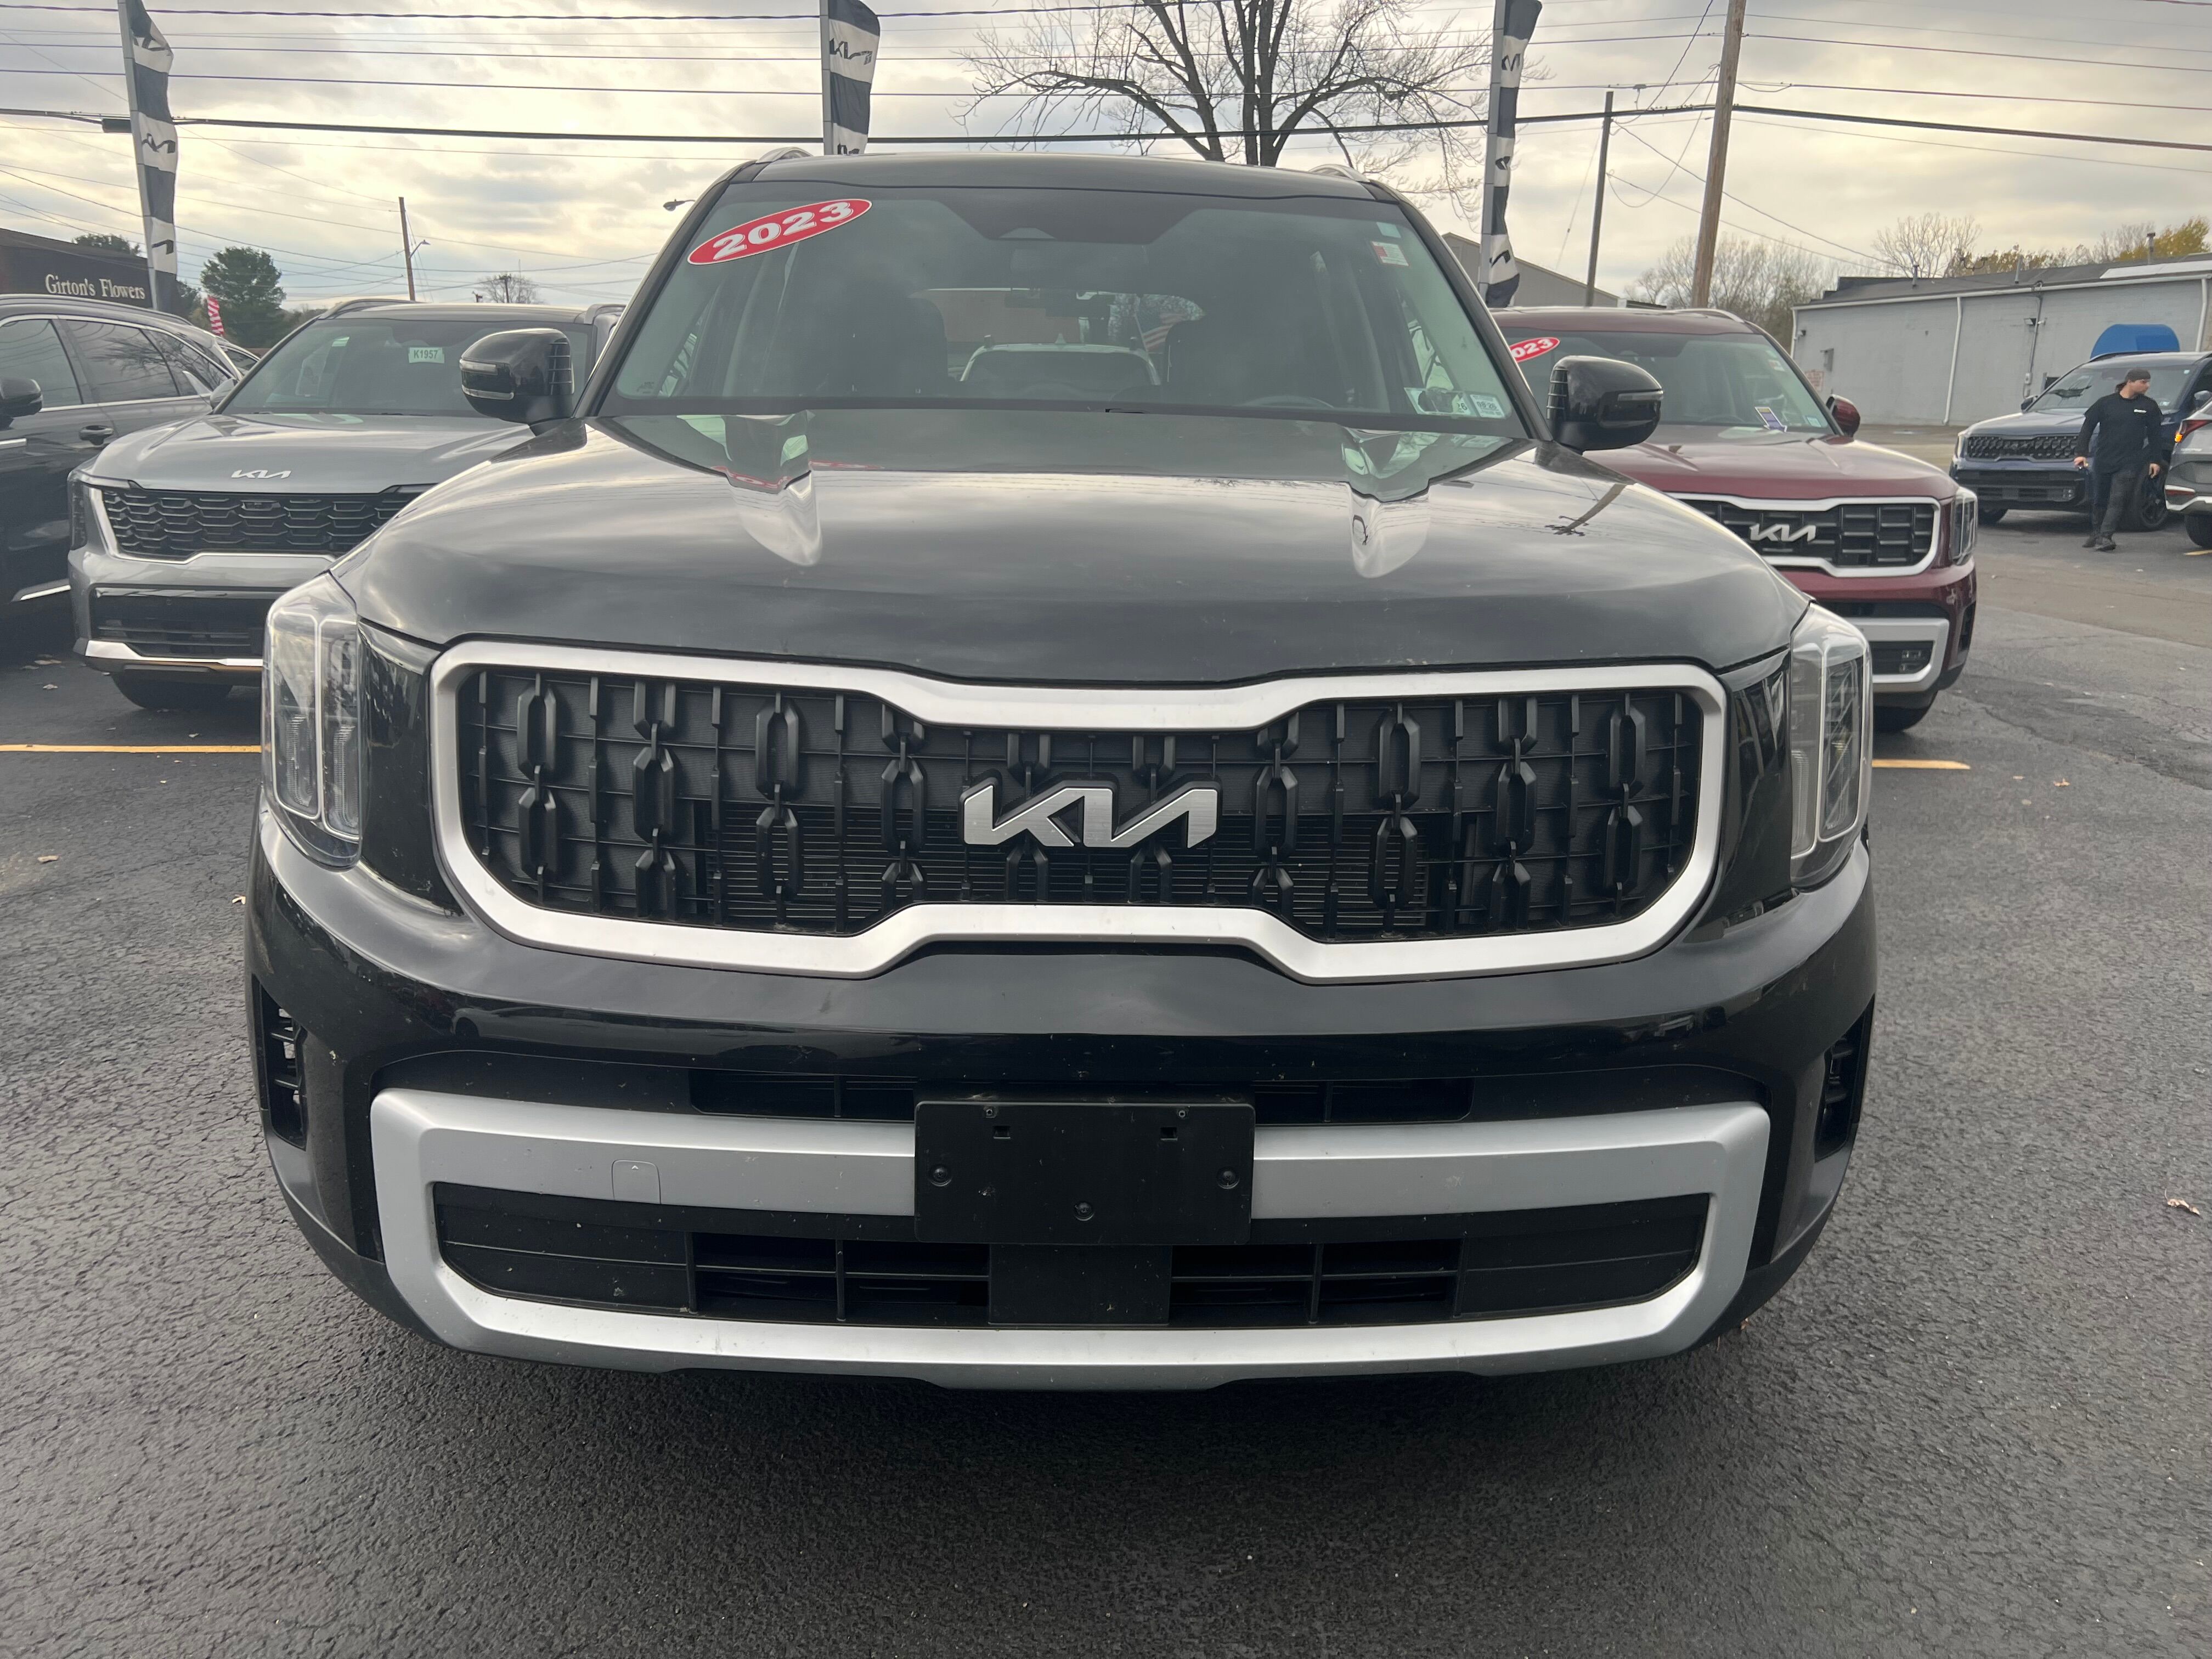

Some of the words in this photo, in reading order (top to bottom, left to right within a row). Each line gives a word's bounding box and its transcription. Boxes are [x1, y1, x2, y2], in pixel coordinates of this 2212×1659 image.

[713, 201, 854, 261] 2023
[45, 274, 96, 296] Girton's
[99, 278, 145, 300] Flowers
[414, 349, 438, 359] K1957
[1511, 338, 1553, 358] 023
[231, 470, 291, 479] KIA
[1750, 523, 1816, 541] KIA
[963, 785, 1218, 848] KIA
